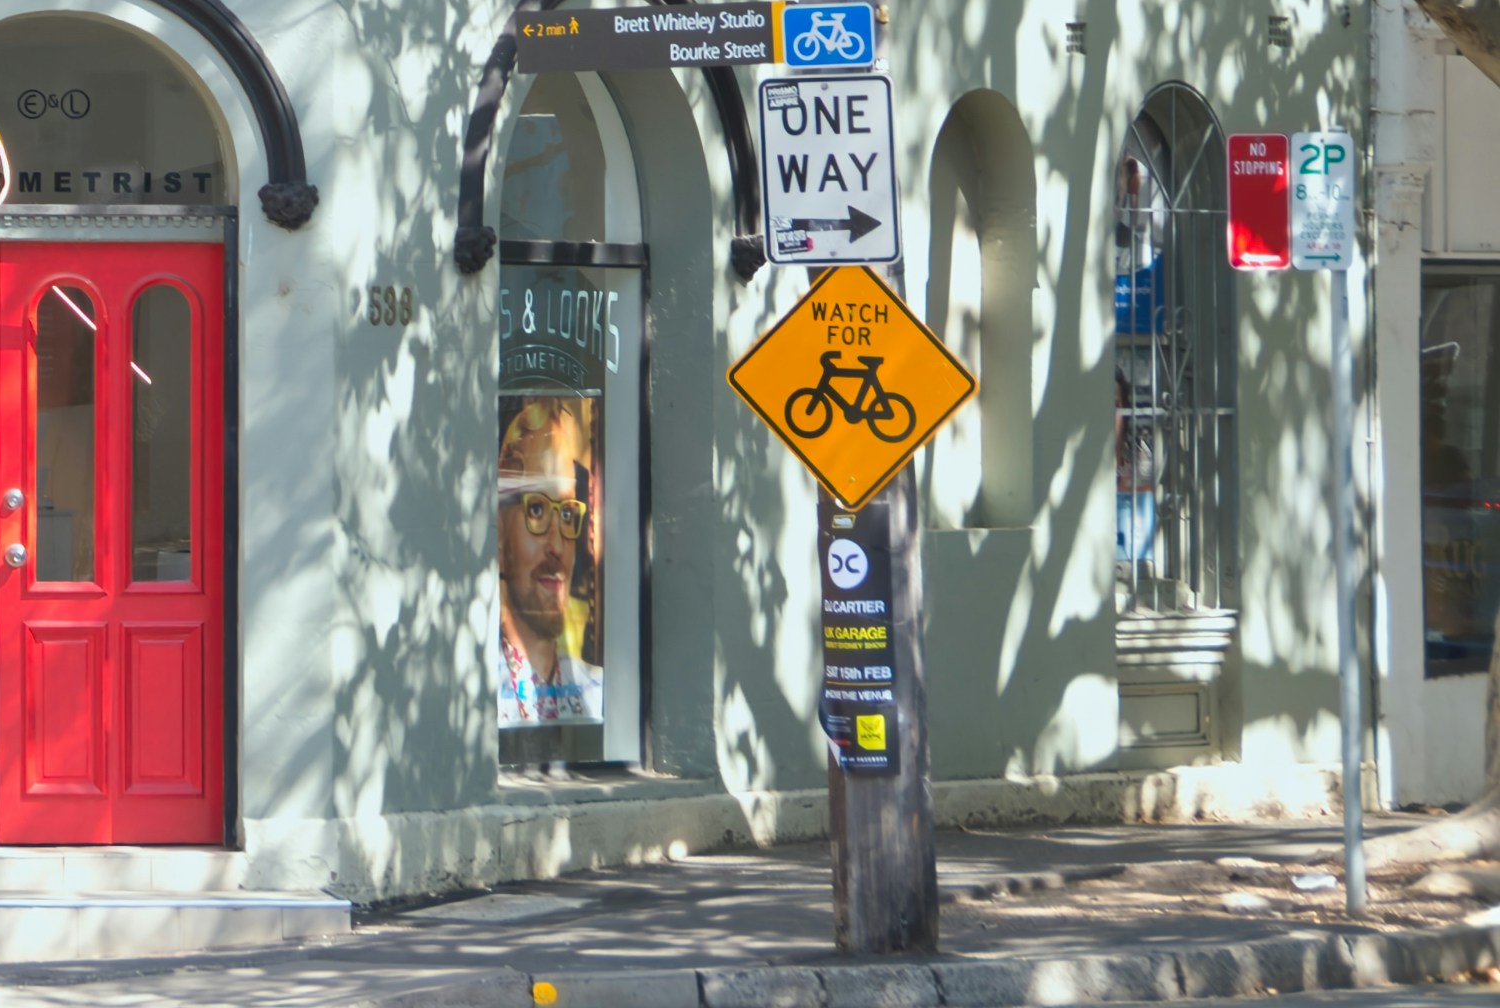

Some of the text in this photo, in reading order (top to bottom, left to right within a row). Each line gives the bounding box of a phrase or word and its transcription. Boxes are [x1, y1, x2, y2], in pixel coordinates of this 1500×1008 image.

[536, 10, 765, 37] 2 min Brett Whiteley Studio
[670, 42, 766, 62] Bourke Street
[782, 95, 871, 136] ONE
[1249, 143, 1267, 156] NO
[1300, 144, 1346, 174] 2P
[777, 152, 879, 193] WAY
[1234, 161, 1284, 175] STOPPING
[811, 302, 889, 323] WATCH
[522, 288, 536, 334] &
[547, 289, 620, 374] LOOKS
[827, 326, 871, 345] FOR
[833, 600, 886, 614] CARTIER
[835, 626, 888, 640] GARAGE
[864, 666, 892, 680] FEB
